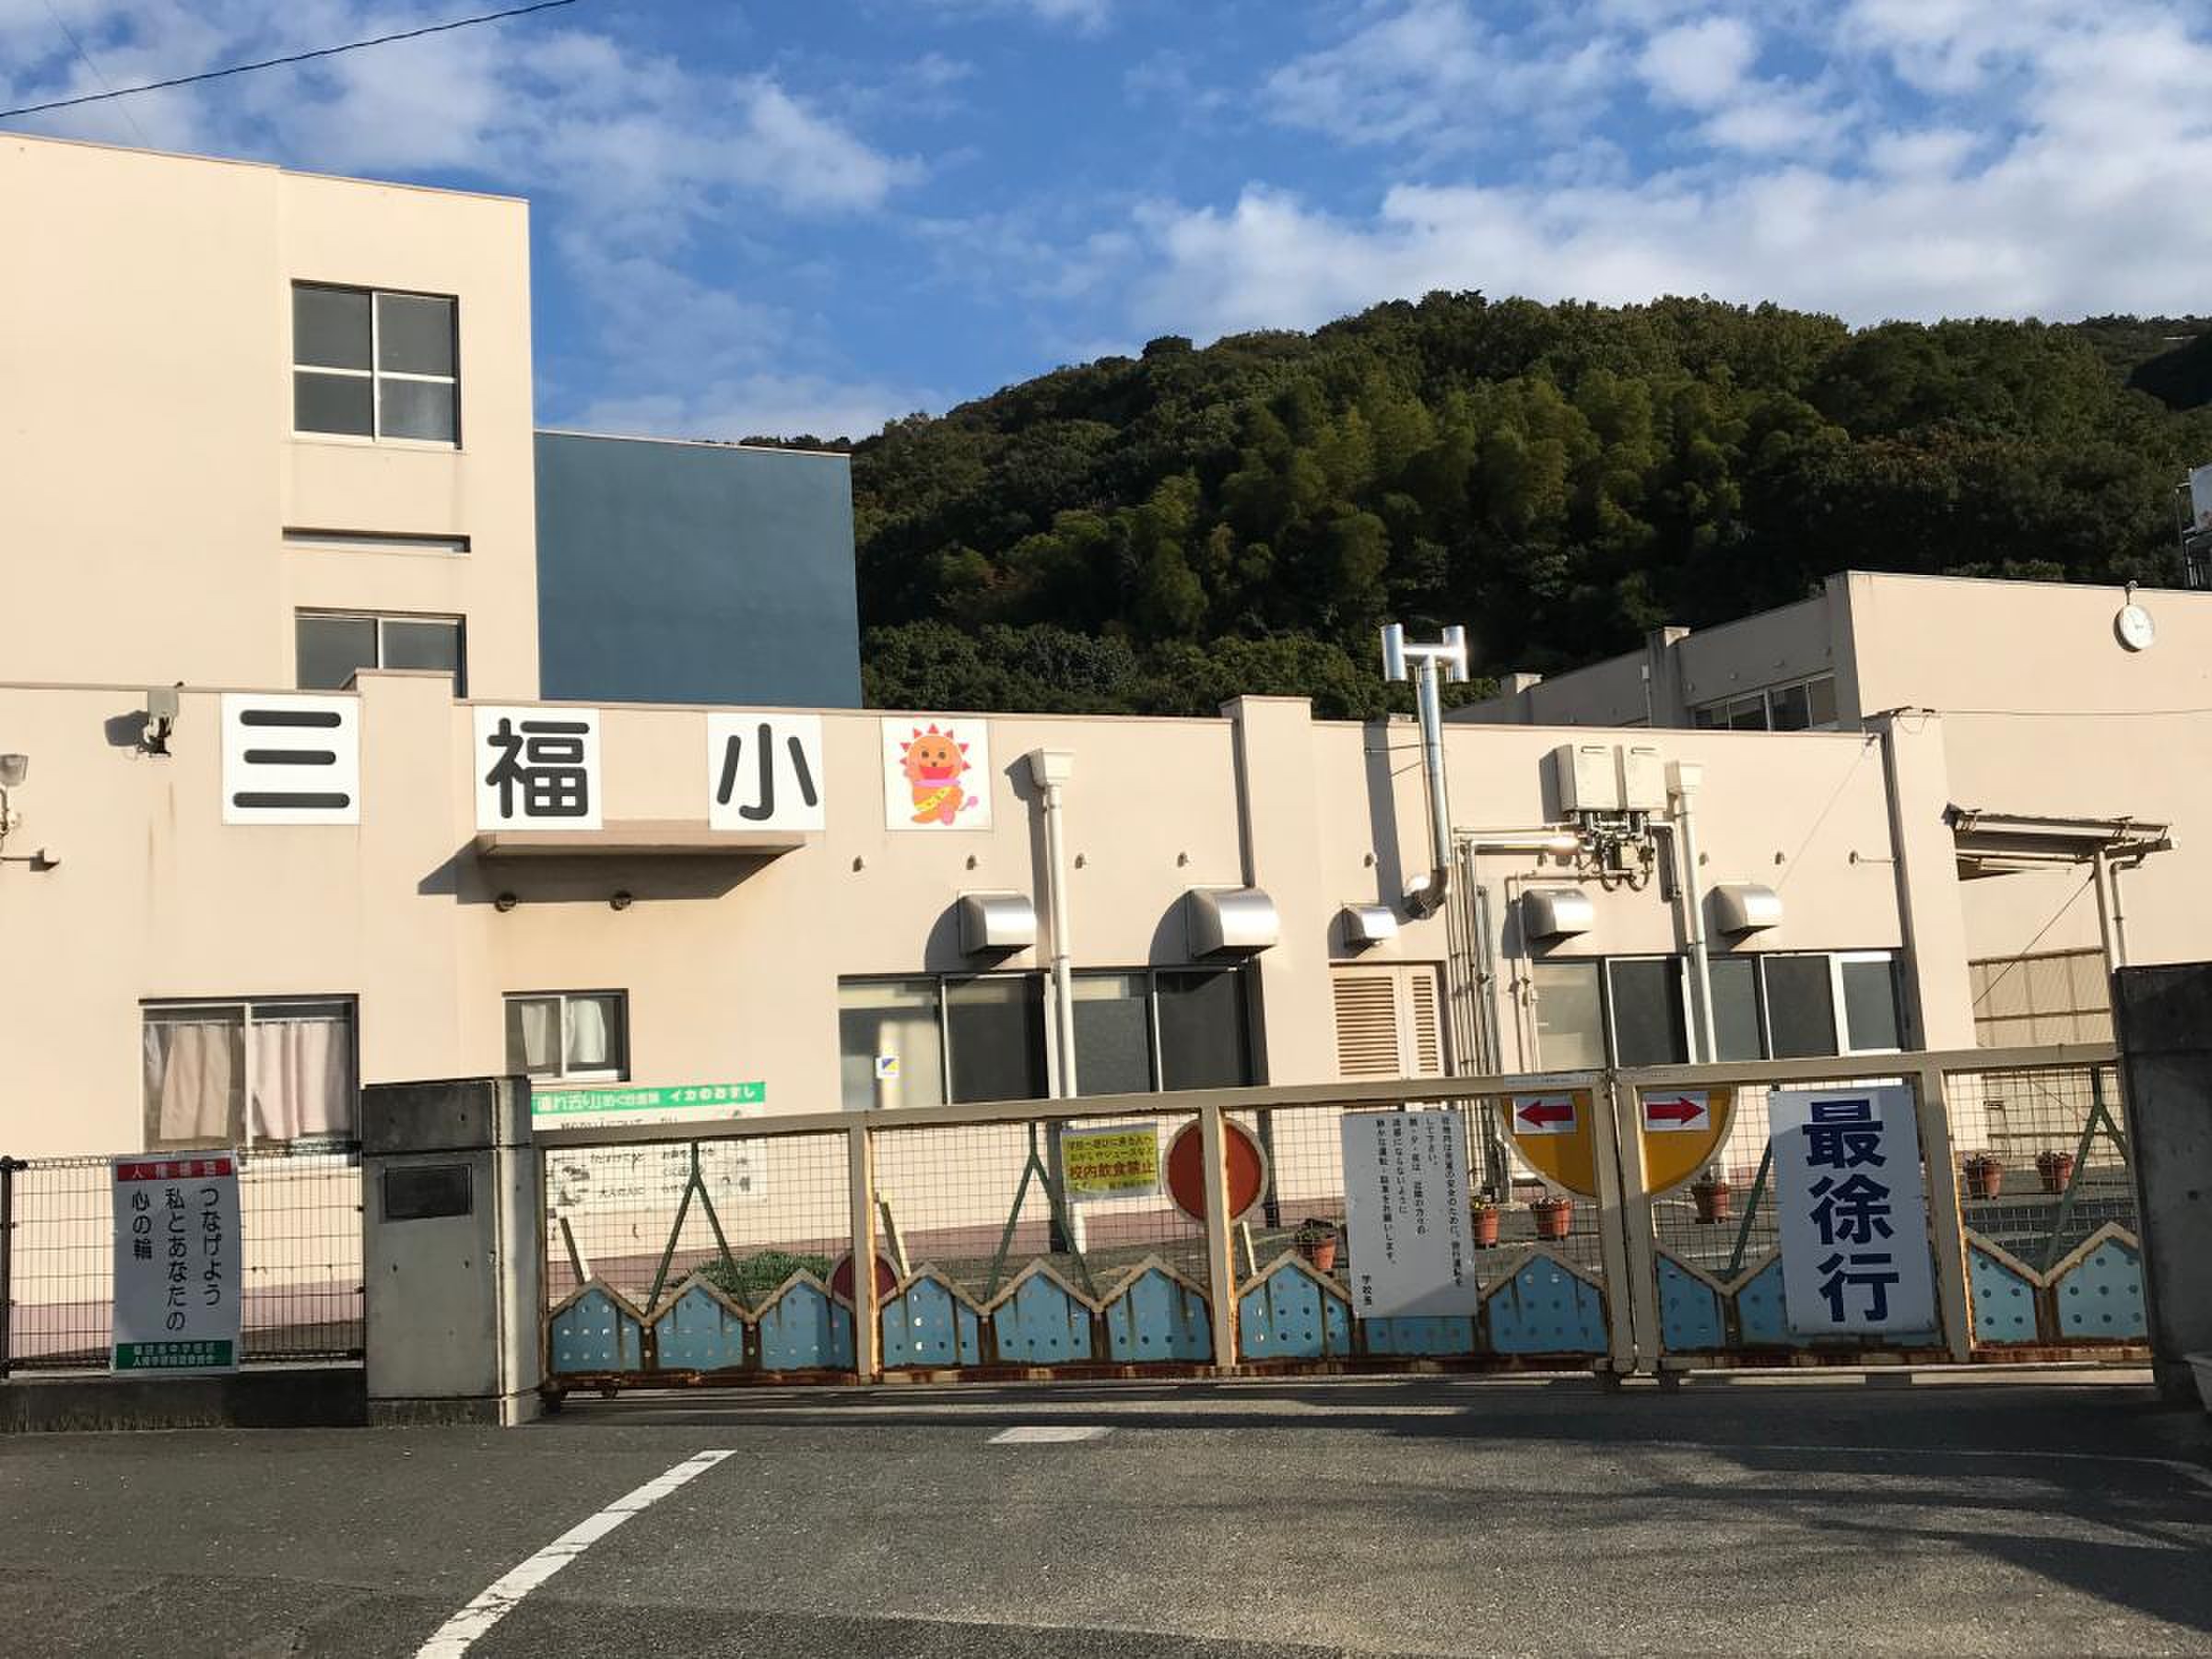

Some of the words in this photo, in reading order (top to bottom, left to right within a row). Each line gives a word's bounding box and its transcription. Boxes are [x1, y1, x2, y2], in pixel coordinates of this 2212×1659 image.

[670, 1085, 756, 1103] イカのおすし
[1069, 1159, 1156, 1180] 校内飲食禁止
[1801, 1098, 1900, 1323] 最徐行
[131, 1189, 153, 1261] 心の輪
[164, 1185, 188, 1332] 私とあなたの
[199, 1187, 222, 1307] つなげよう
